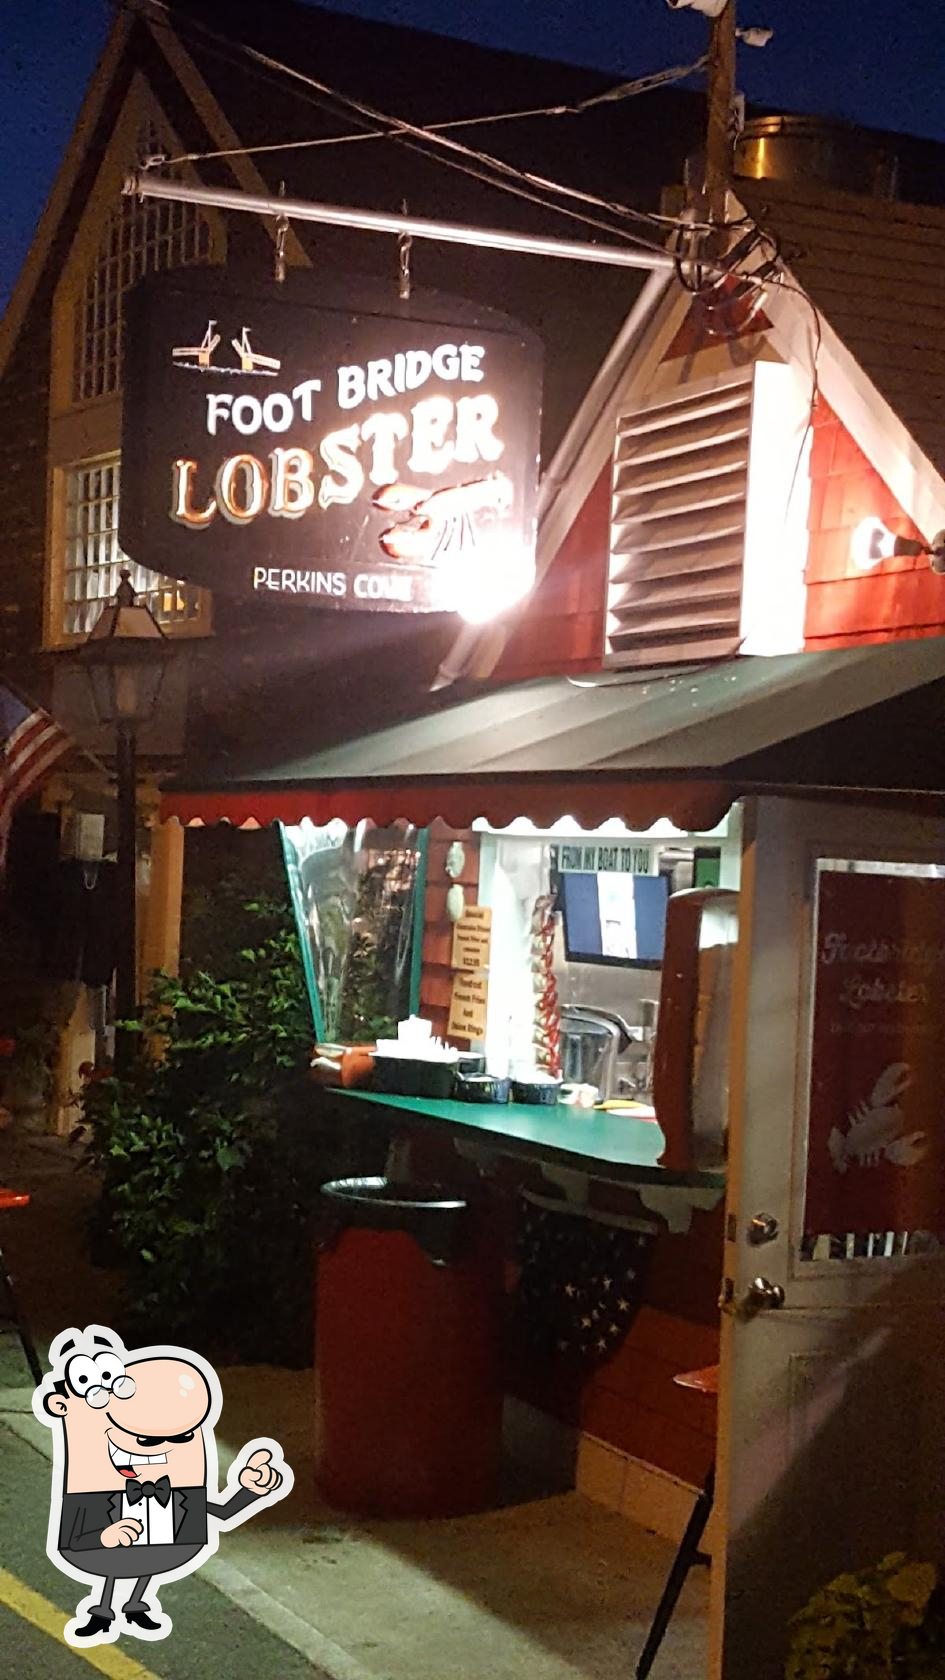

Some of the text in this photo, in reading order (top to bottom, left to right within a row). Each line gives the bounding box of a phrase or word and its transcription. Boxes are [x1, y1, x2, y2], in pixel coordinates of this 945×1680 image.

[206, 343, 486, 437] FOOT BRIDGE
[169, 393, 505, 530] LOBSTER
[253, 566, 347, 597] PERKINS
[598, 847, 618, 871] BOAT
[621, 847, 631, 872] TO
[633, 848, 650, 874] YOU
